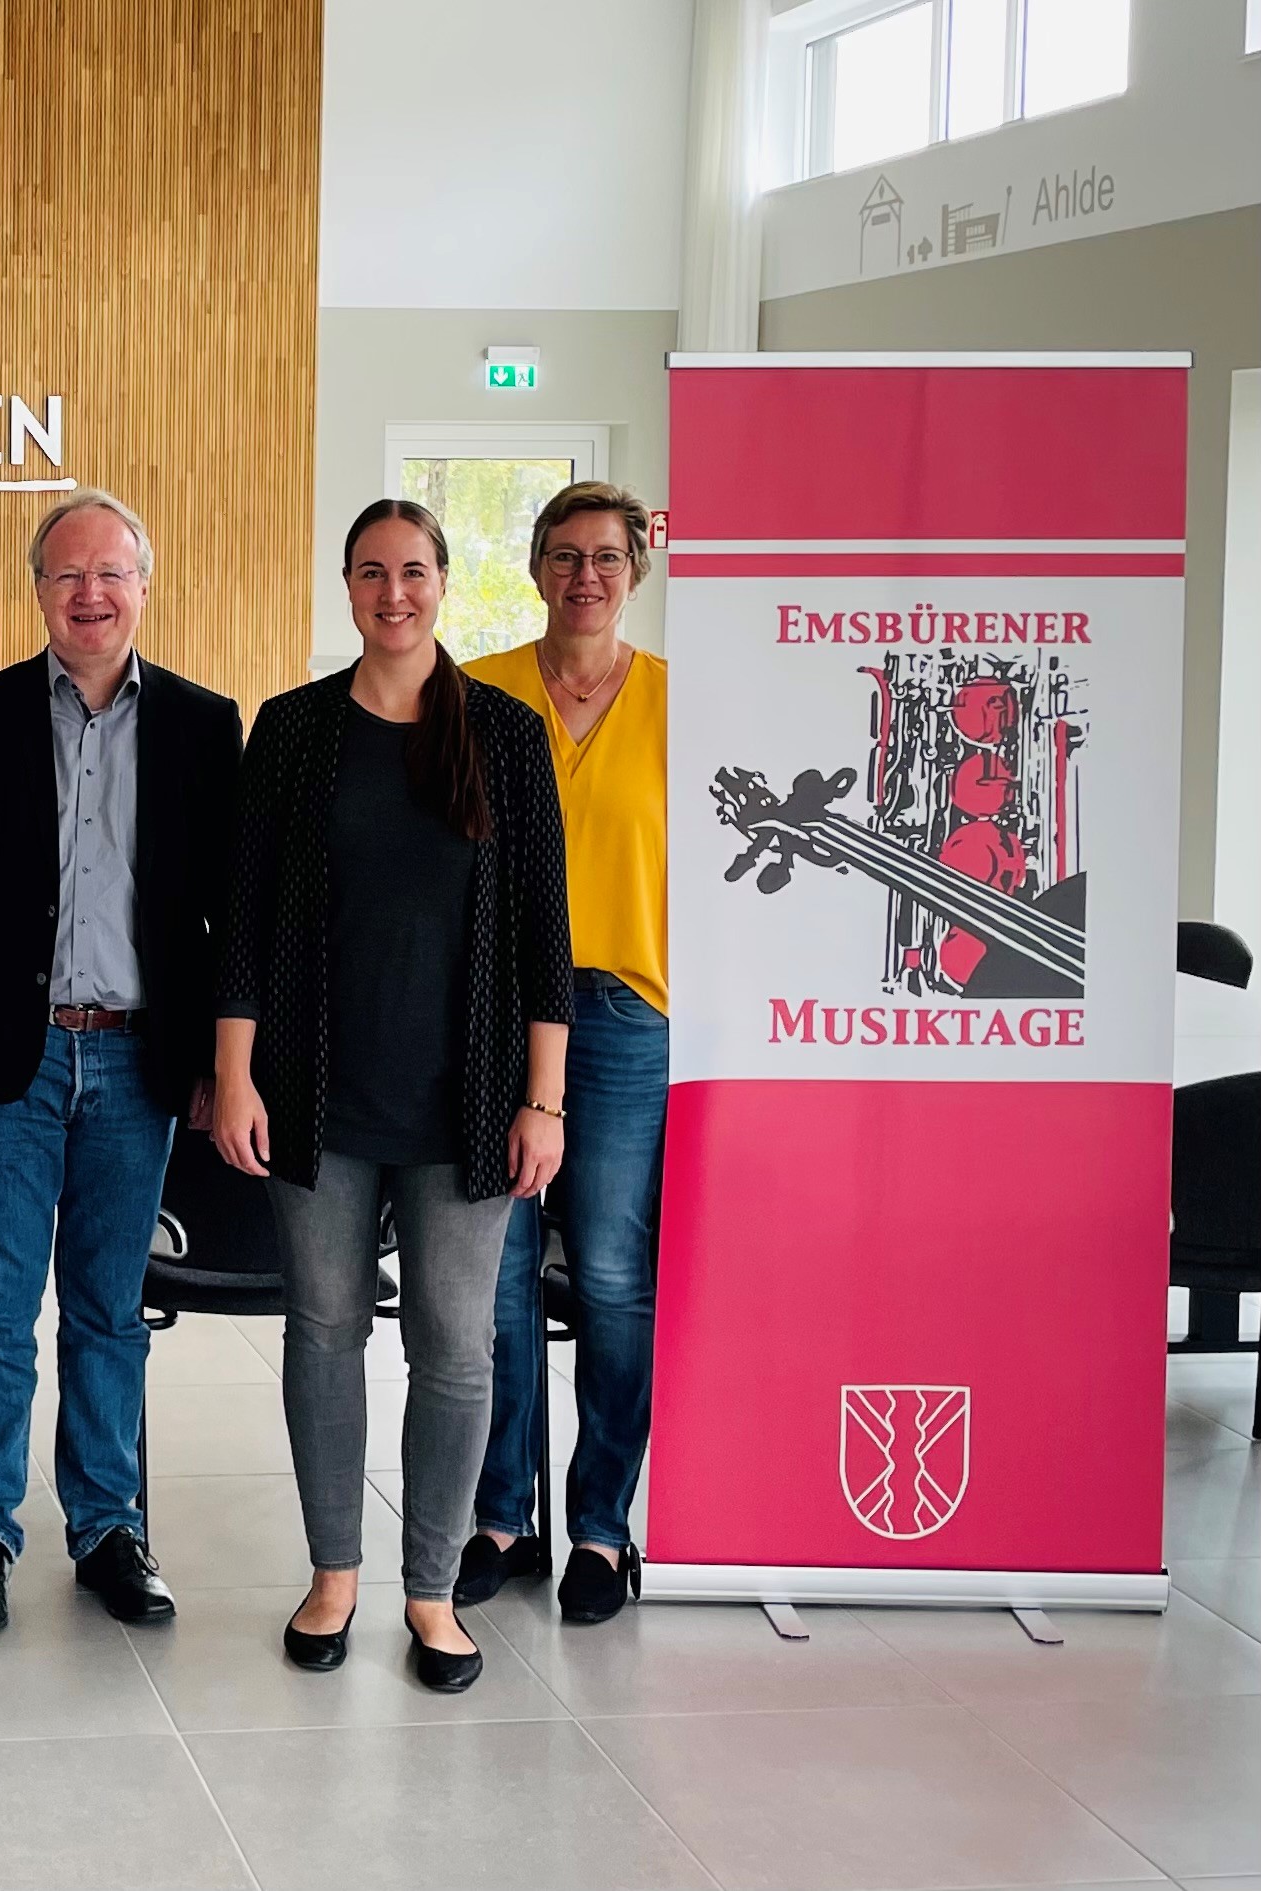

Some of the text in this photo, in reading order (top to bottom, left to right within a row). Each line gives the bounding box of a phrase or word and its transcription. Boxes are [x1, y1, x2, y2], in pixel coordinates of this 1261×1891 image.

[1032, 165, 1115, 226] Ahlde
[776, 603, 1092, 645] EMSBÜRENER
[768, 998, 1085, 1047] MUSIKTAGE
